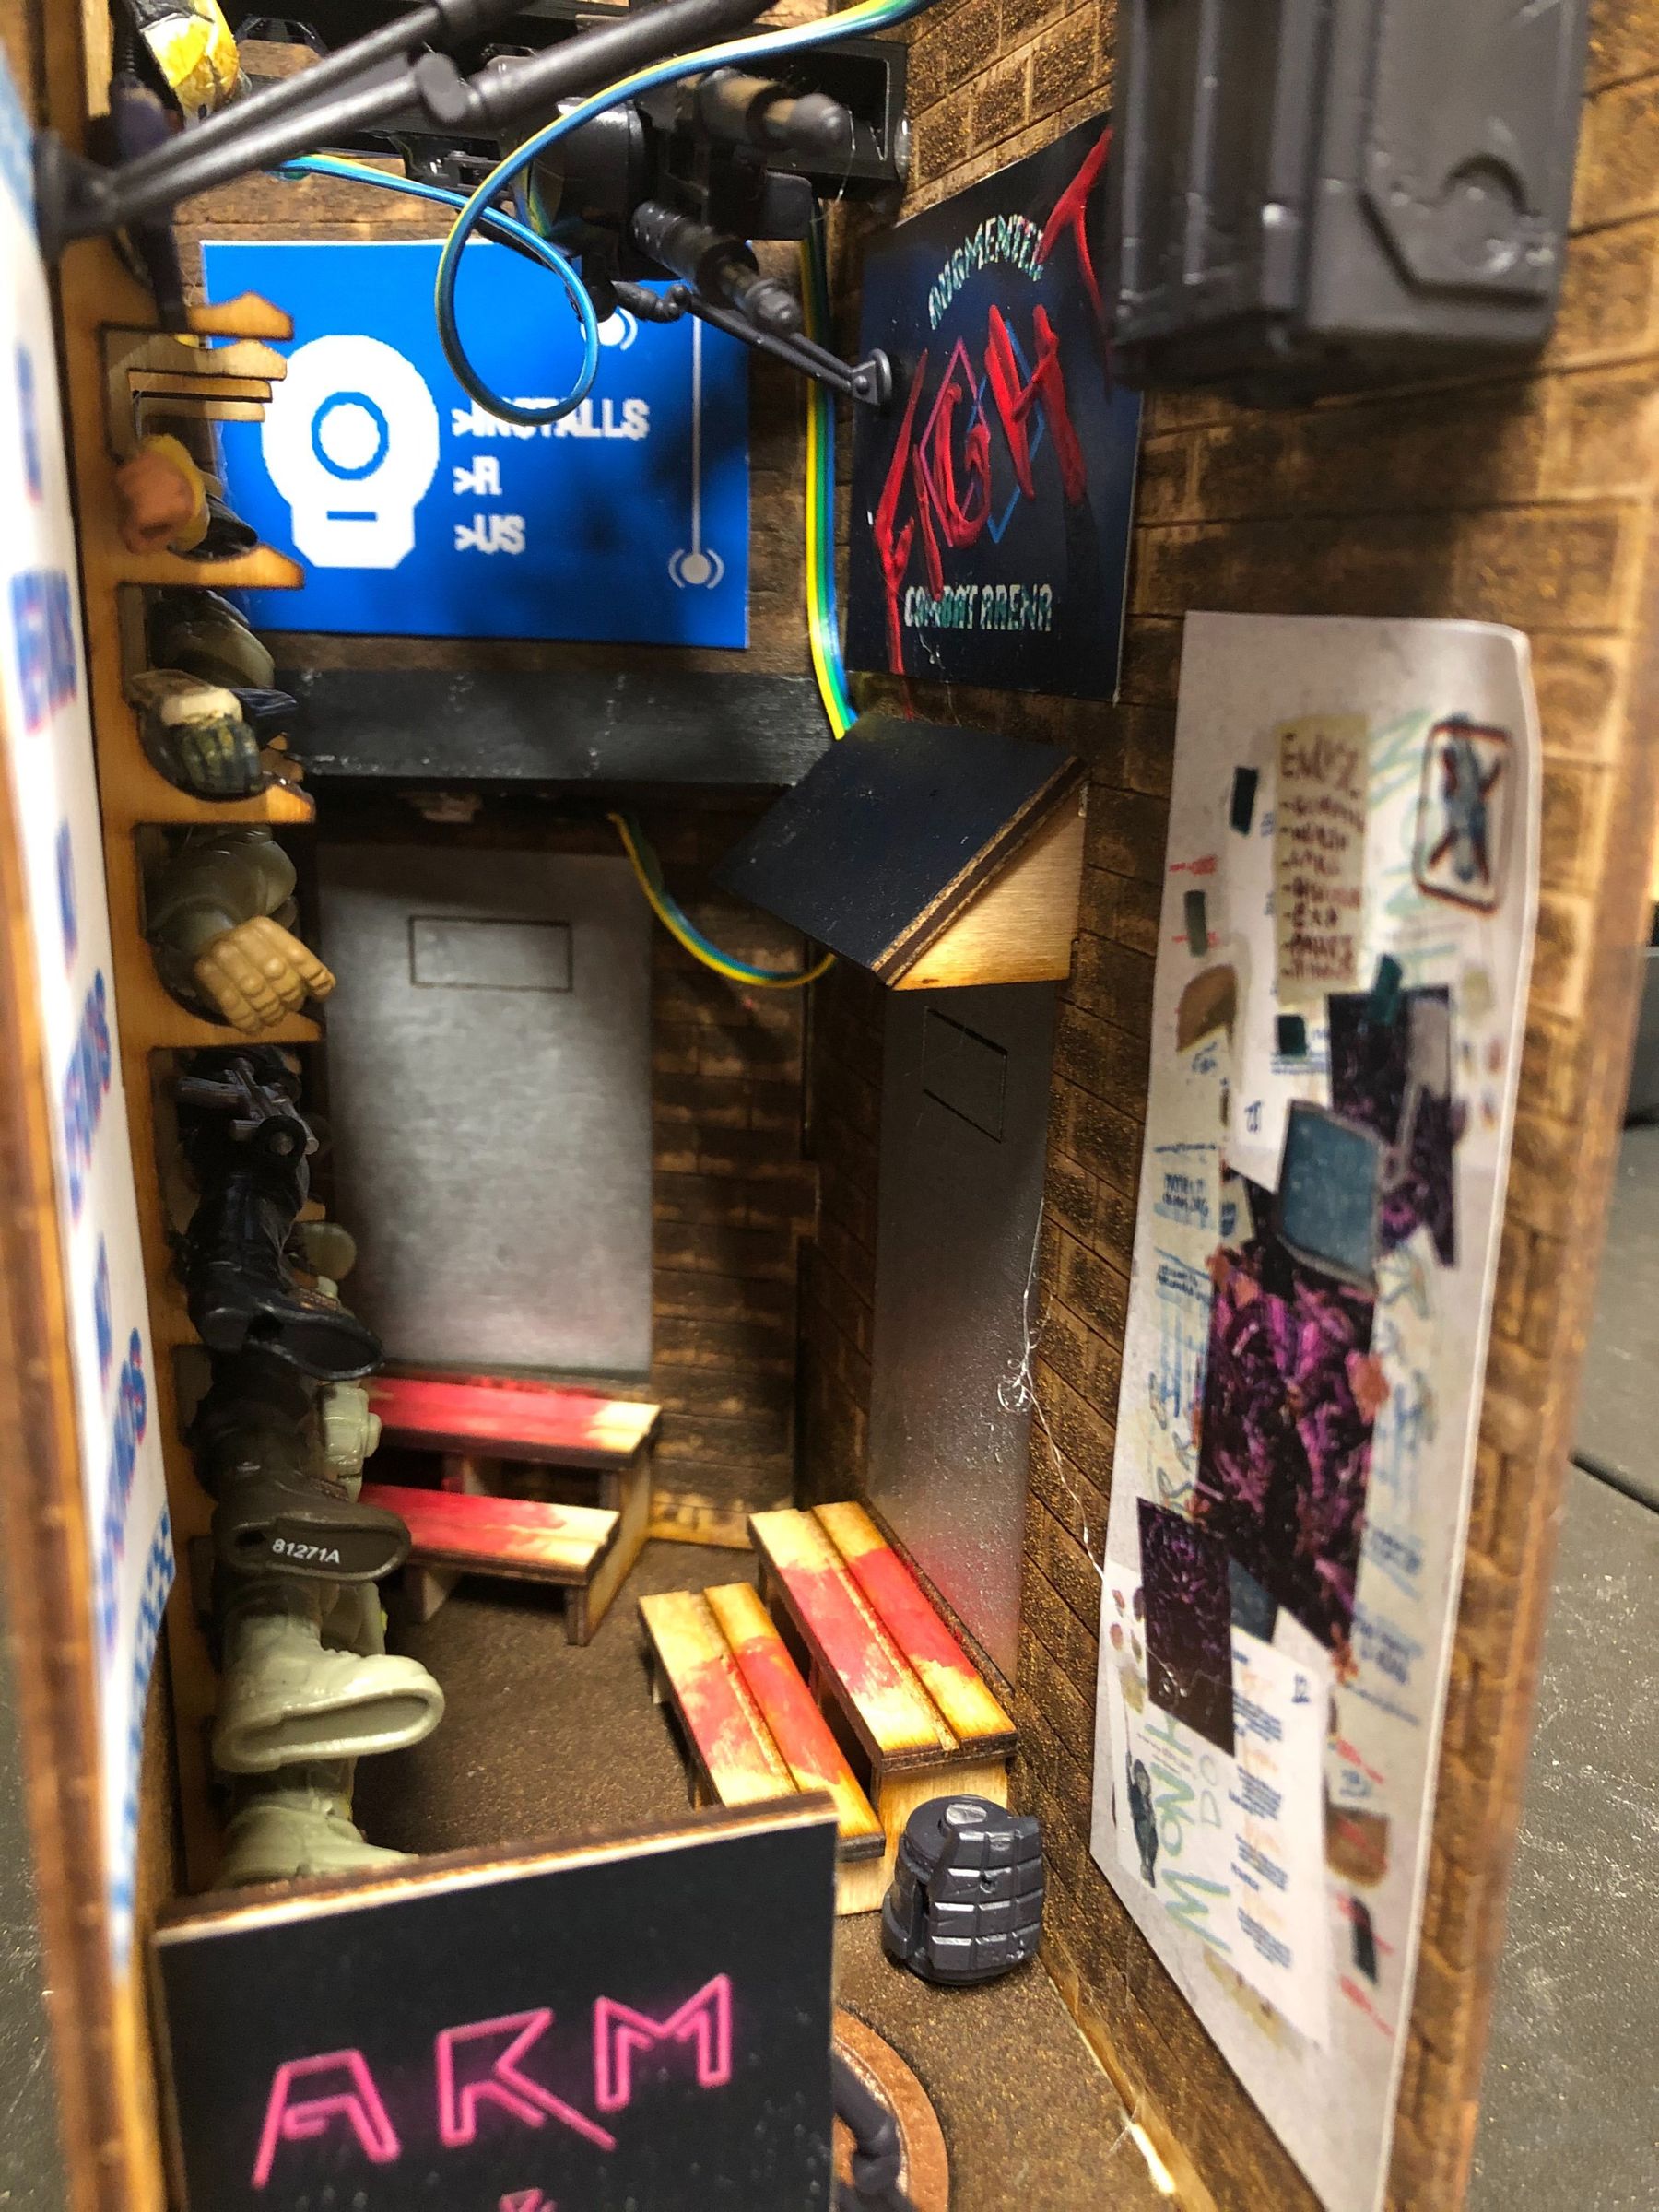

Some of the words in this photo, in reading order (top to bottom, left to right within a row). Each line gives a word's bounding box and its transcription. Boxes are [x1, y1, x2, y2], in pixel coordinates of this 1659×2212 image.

[980, 583, 1053, 632] ARENA
[271, 1537, 341, 1564] 81271A
[252, 1972, 734, 2191] ARM
